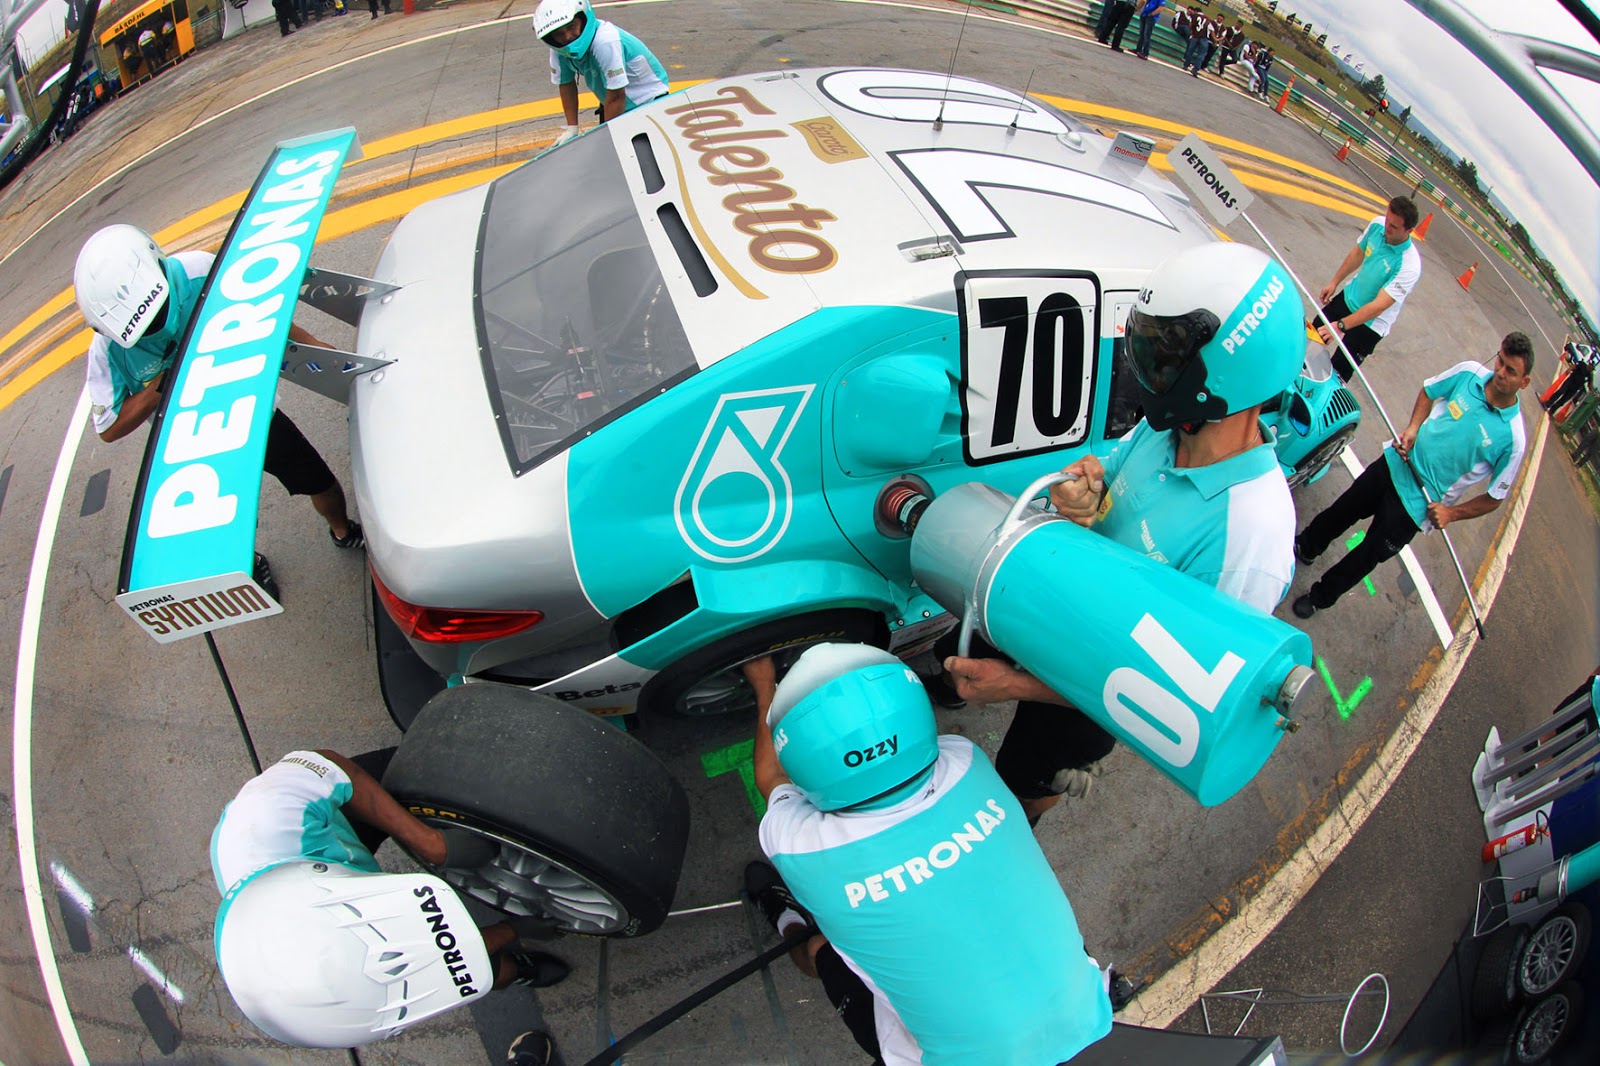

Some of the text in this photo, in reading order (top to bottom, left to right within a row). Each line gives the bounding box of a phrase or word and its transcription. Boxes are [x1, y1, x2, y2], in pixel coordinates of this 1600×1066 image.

[537, 15, 568, 34] PETRONAS
[803, 121, 850, 156] Garoto
[664, 86, 839, 275] Talento
[1181, 147, 1237, 208] PETRONAS
[121, 282, 164, 342] PETRONAS
[147, 149, 340, 539] PETRONAS
[1221, 274, 1285, 355] PETRONAS
[977, 291, 1085, 448] 70
[129, 594, 175, 613] PETRONAS
[138, 584, 271, 635] SYNTIUM
[1103, 612, 1246, 768] 70
[843, 734, 899, 768] Ozzy
[844, 798, 1006, 909] PETRONAS
[413, 885, 479, 998] PETRONAS
